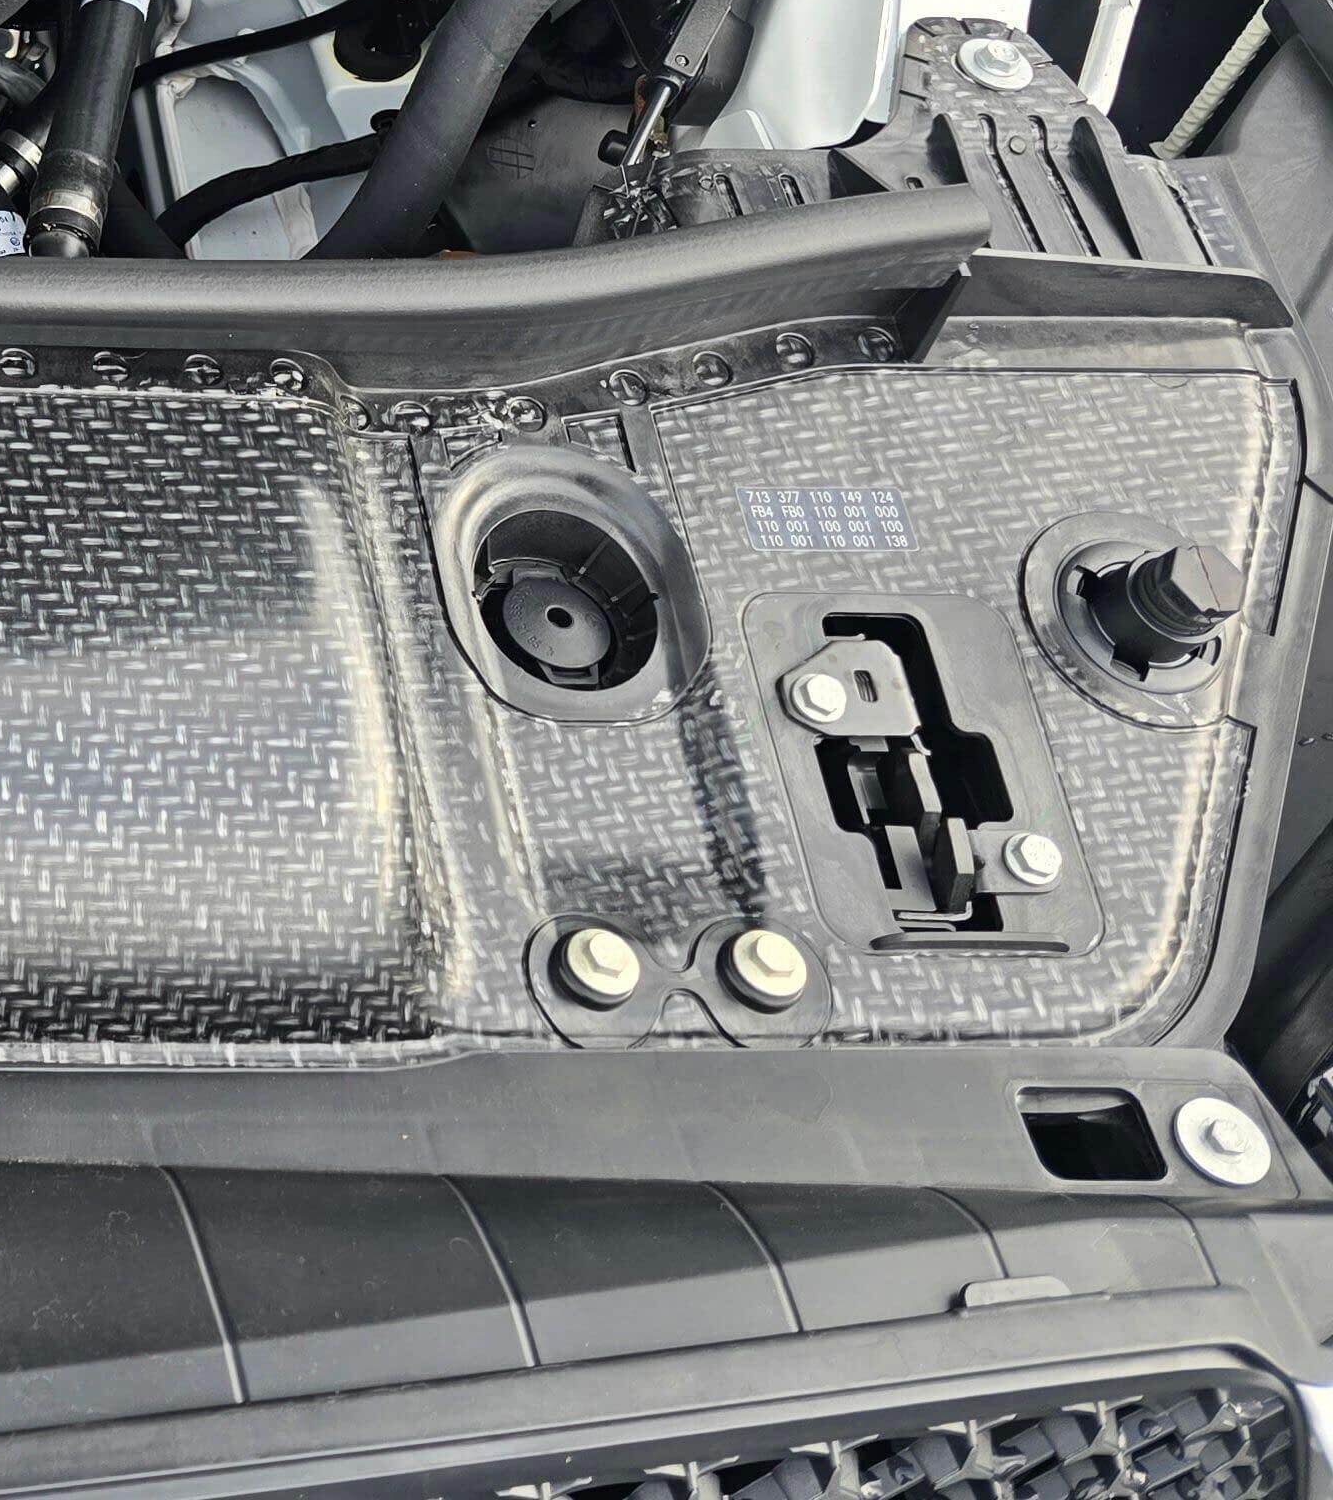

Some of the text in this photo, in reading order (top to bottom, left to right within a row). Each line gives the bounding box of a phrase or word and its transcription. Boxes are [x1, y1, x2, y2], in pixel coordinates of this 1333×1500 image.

[746, 491, 894, 503] 713 377 110 149 124
[751, 505, 898, 518] FB4 FB0 110 001 000
[757, 520, 904, 533] 110 001 100 001 100
[761, 535, 908, 547] 110 001 110 001 138
